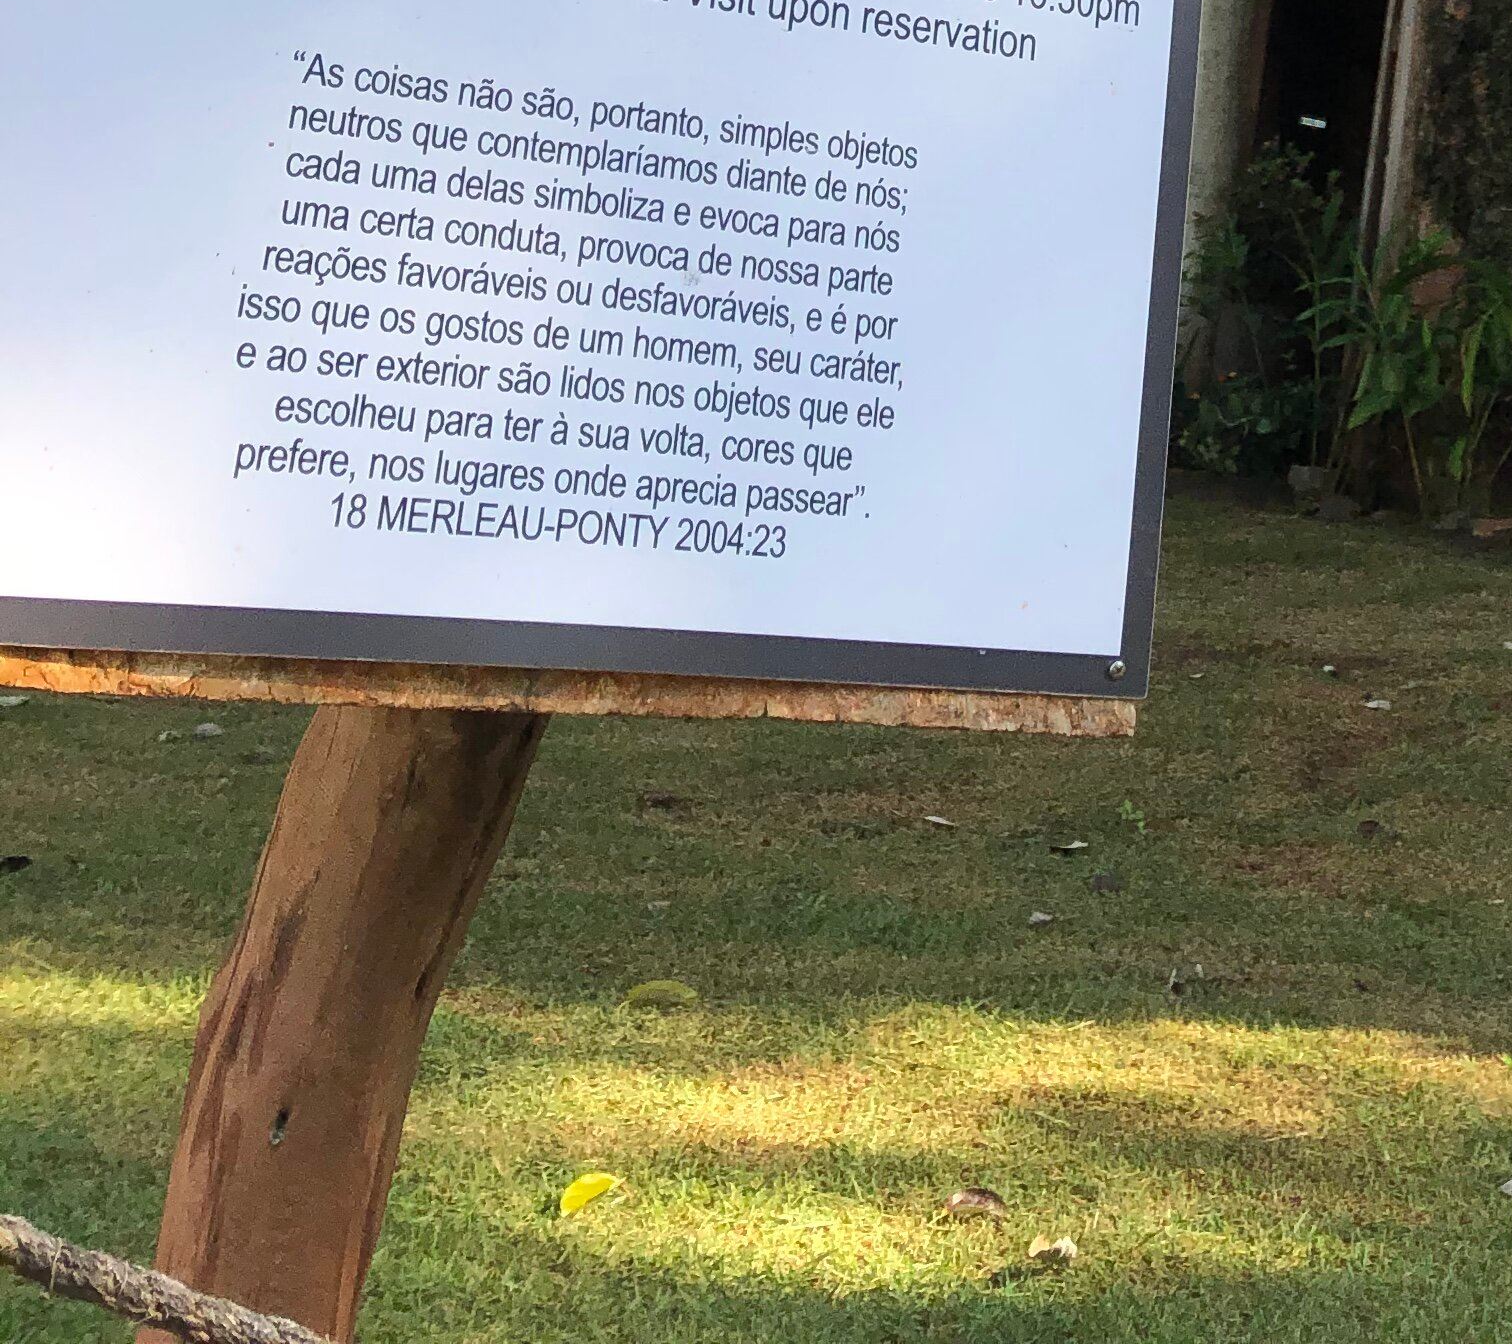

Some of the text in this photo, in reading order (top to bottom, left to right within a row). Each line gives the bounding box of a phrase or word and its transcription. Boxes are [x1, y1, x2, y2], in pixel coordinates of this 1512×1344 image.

[861, 7, 1037, 62] reservation
[288, 104, 909, 217] neutros que contemplaríamos diante de nós;
[354, 64, 449, 104] coisas
[457, 78, 513, 113] não
[520, 86, 580, 128] são,
[589, 101, 709, 146] portanto,
[719, 113, 820, 157] simples
[827, 129, 918, 170] objetos
[281, 199, 893, 298] uma certa conduta, provoca de nossa parte
[285, 149, 901, 254] cada uma delas simboliza e evoca para nós
[237, 283, 903, 392] isso que os gostos de um homem, seu caráter,
[262, 245, 899, 345] reações favoráveis ou desfavoráveis, e é por
[236, 342, 895, 431] e ao ser exterior são lidos nos objetos que ele
[274, 393, 853, 477] escolheu para ter à sua volta, cores que
[232, 437, 356, 485] prefere,
[368, 453, 426, 483] nos
[434, 449, 546, 497] lugares
[554, 463, 627, 499] onde
[635, 472, 737, 511] aprecia
[331, 491, 787, 559] 18 MERLEAU-PONTY 2004:23
